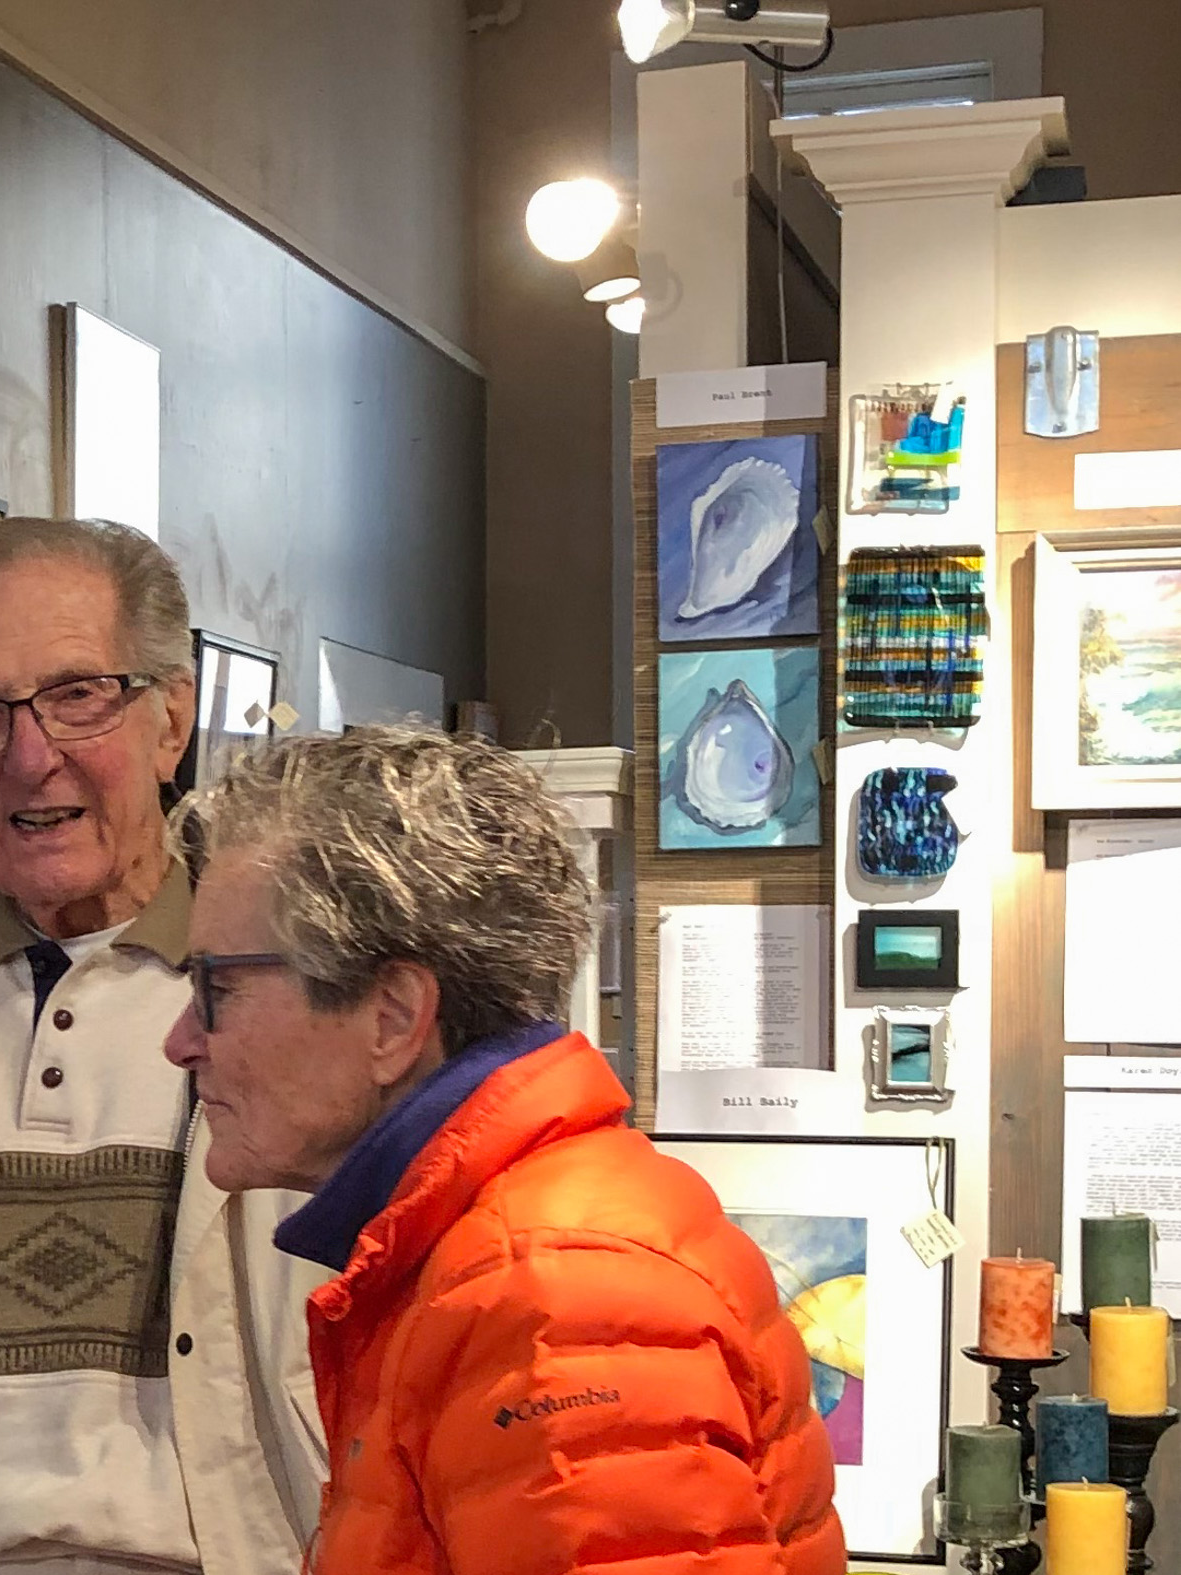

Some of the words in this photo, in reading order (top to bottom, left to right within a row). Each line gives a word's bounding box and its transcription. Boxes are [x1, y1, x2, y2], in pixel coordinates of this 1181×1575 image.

[712, 391, 736, 401] Paul
[1159, 1067, 1181, 1076] Doy
[722, 1096, 753, 1107] Bill
[514, 1386, 621, 1421] Columbia
